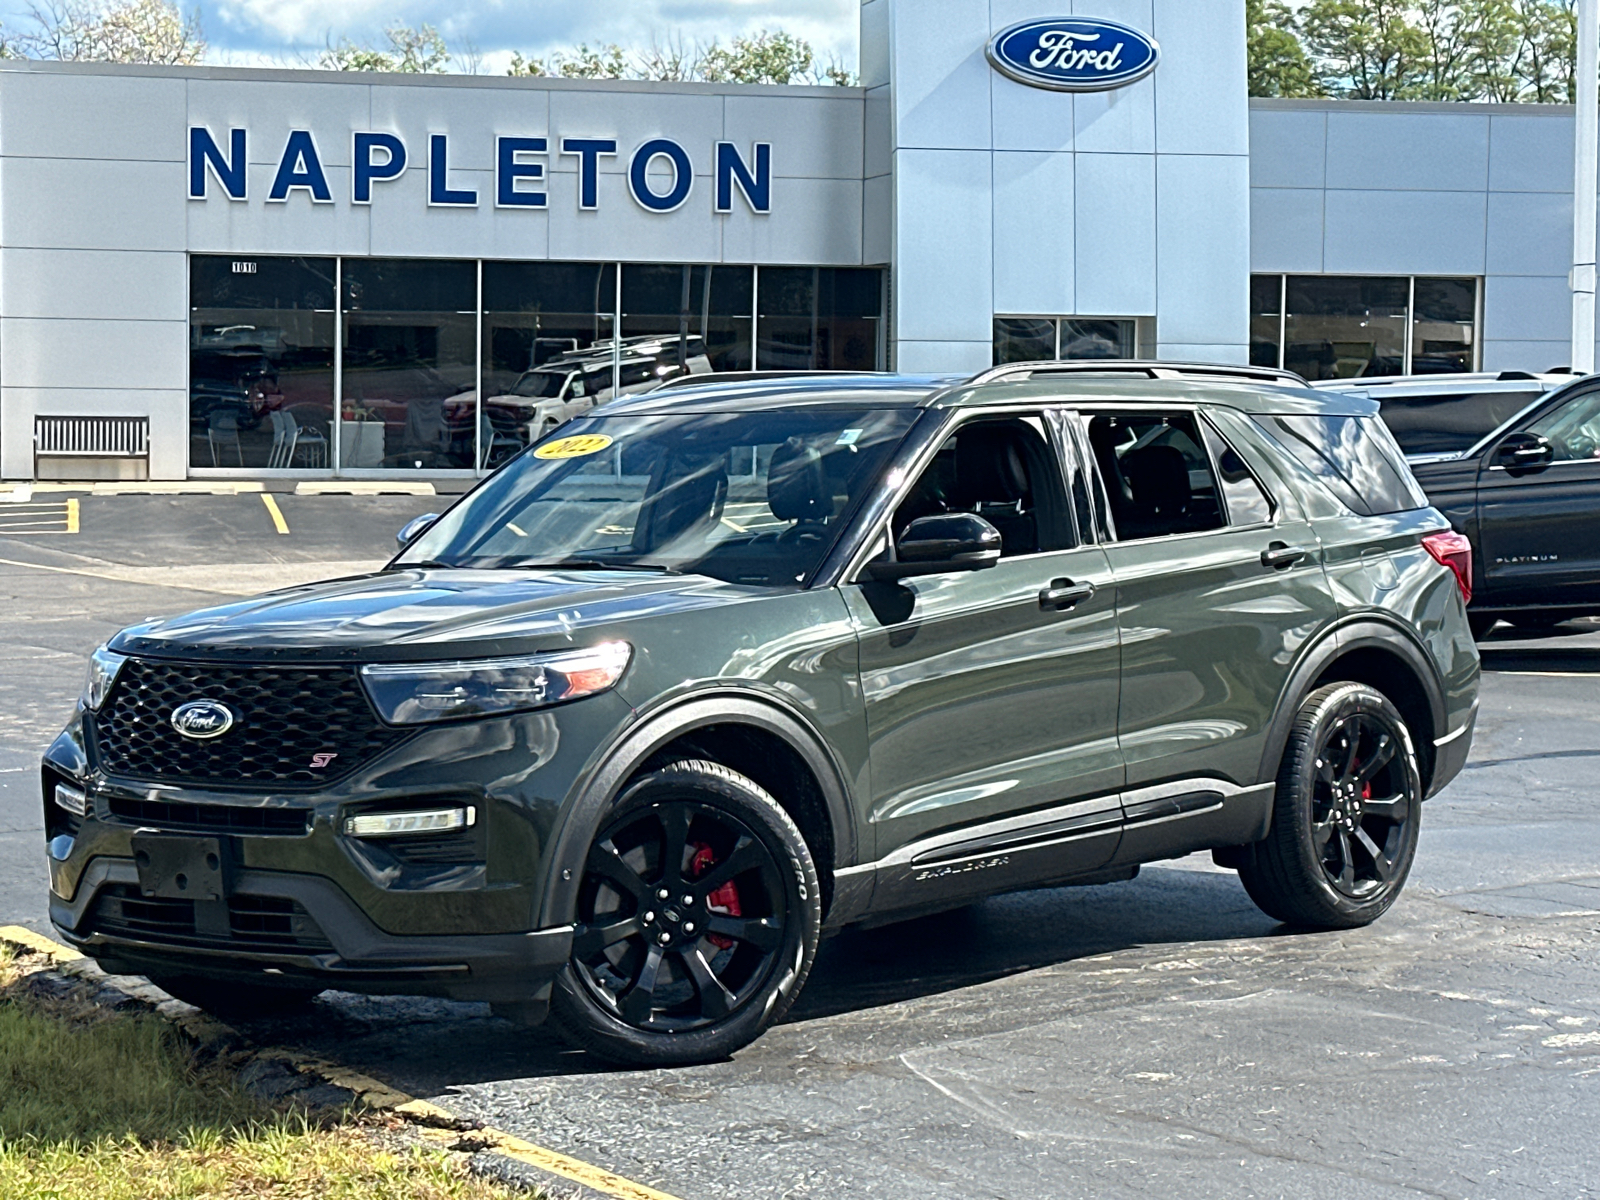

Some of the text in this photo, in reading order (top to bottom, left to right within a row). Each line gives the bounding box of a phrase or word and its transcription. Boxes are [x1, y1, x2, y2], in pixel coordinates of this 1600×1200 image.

[1029, 30, 1124, 71] Ford
[187, 124, 772, 214] NAPLETON
[232, 262, 257, 273] 1010
[1495, 554, 1558, 563] PLATINUM
[182, 707, 220, 730] Ford
[309, 752, 338, 768] ST
[915, 856, 1010, 881] EXPLORER
